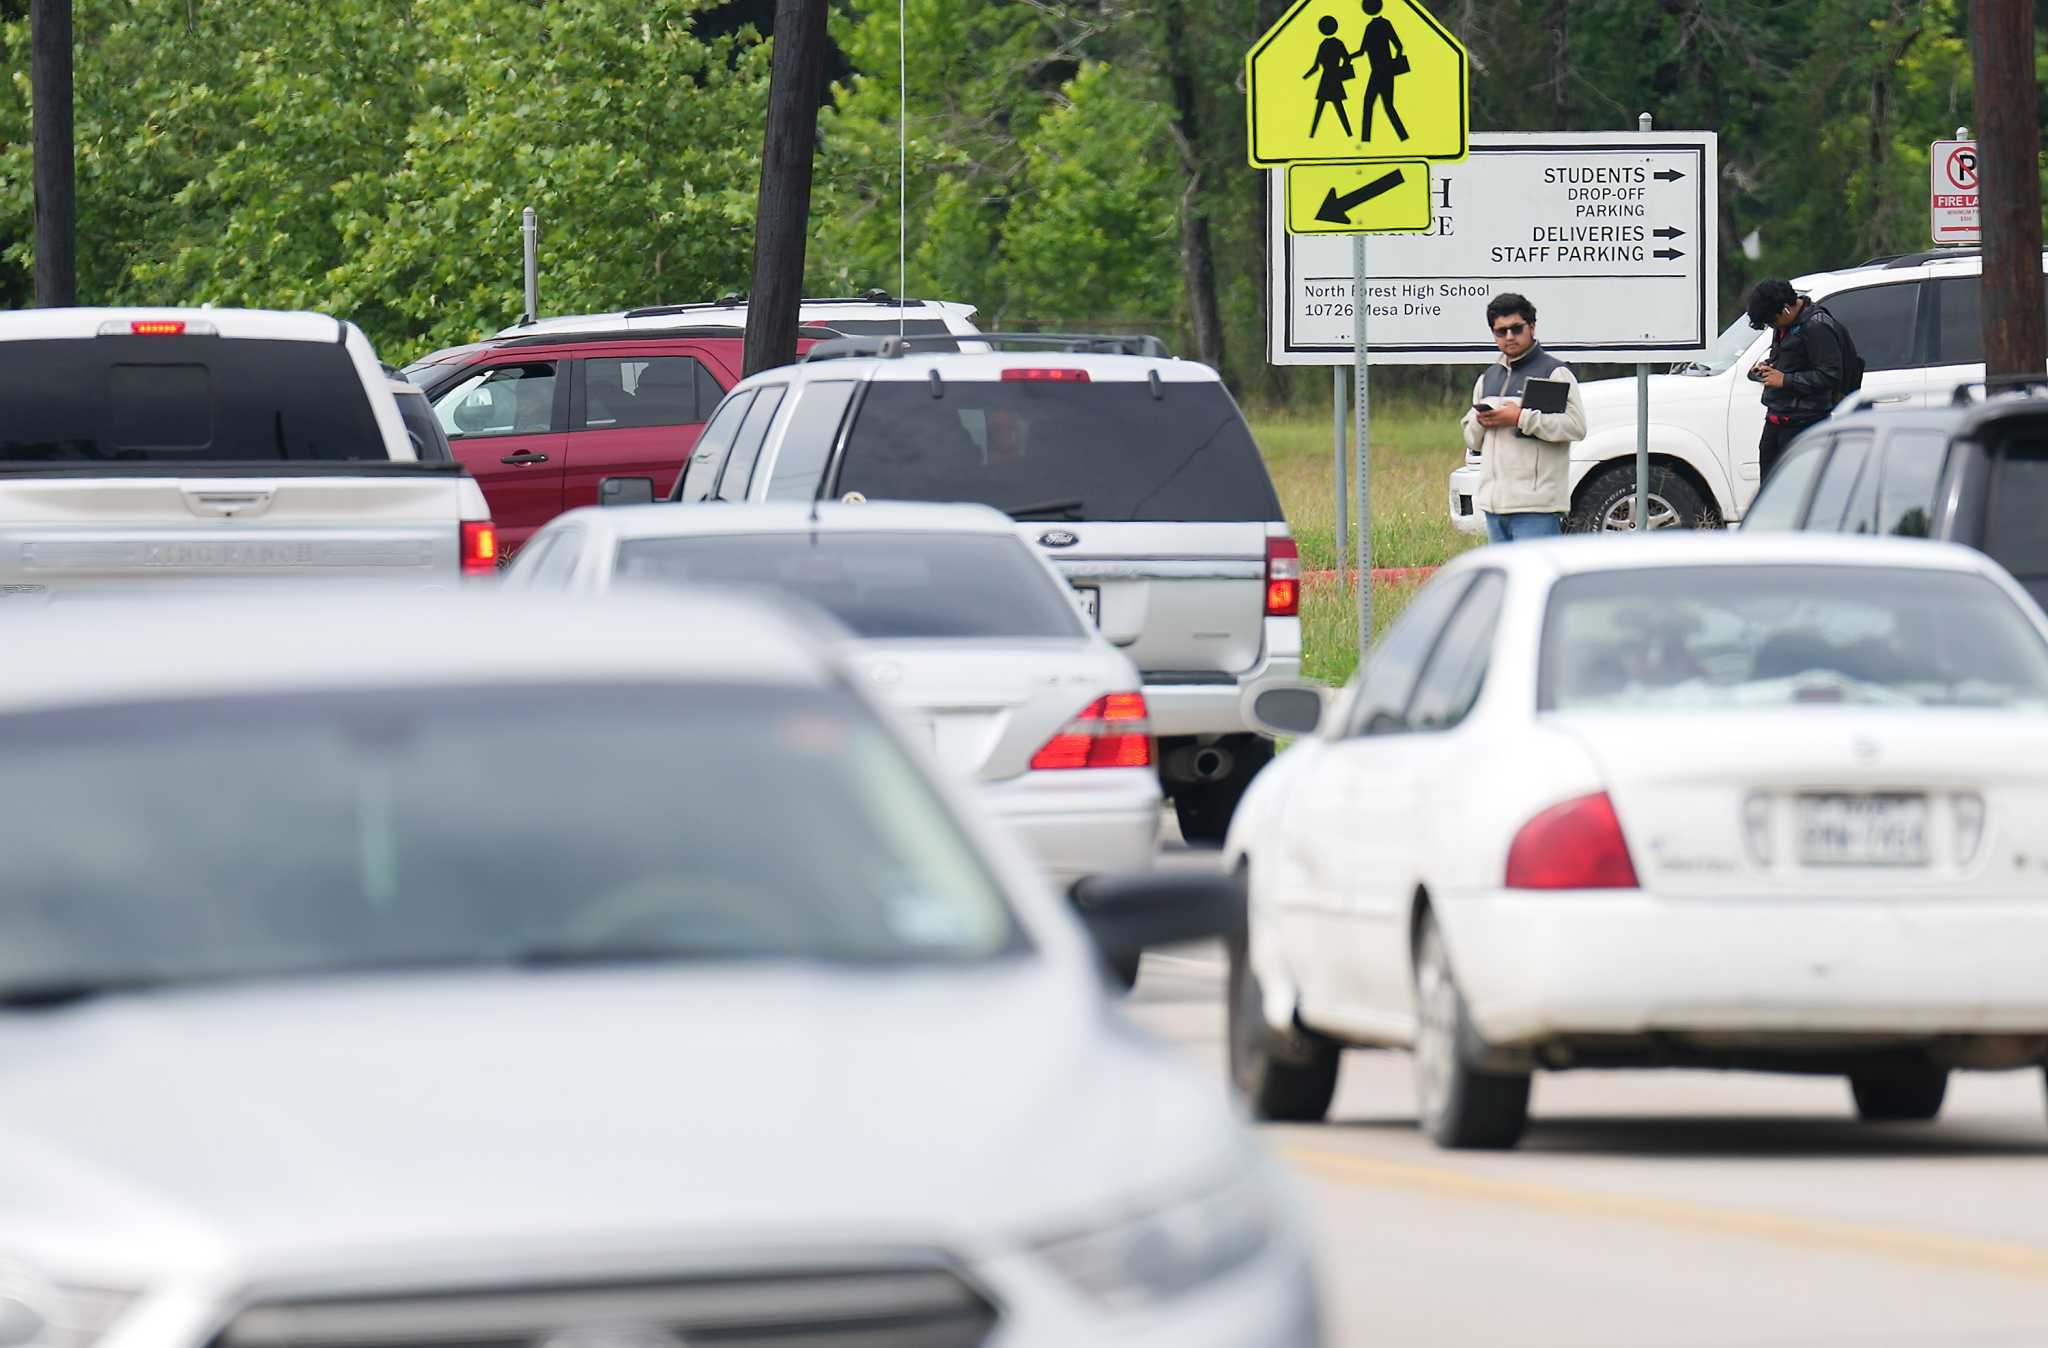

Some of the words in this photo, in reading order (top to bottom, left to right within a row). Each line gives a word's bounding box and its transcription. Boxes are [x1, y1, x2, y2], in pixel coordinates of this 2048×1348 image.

[1544, 167, 1645, 183] STUDENTS
[1569, 188, 1645, 200] DROP-OFF
[1938, 196, 1963, 206] FIRE
[1966, 196, 1979, 206] LA
[1577, 205, 1644, 217] PARKING
[1534, 226, 1644, 241] DELIVERIES
[1492, 247, 1550, 262] STAFF
[1558, 246, 1643, 261] PARKING
[1306, 285, 1344, 297] North
[1403, 285, 1434, 299] High
[1440, 284, 1489, 296] School
[1306, 304, 1353, 316] 10726
[1405, 304, 1440, 315] Drive
